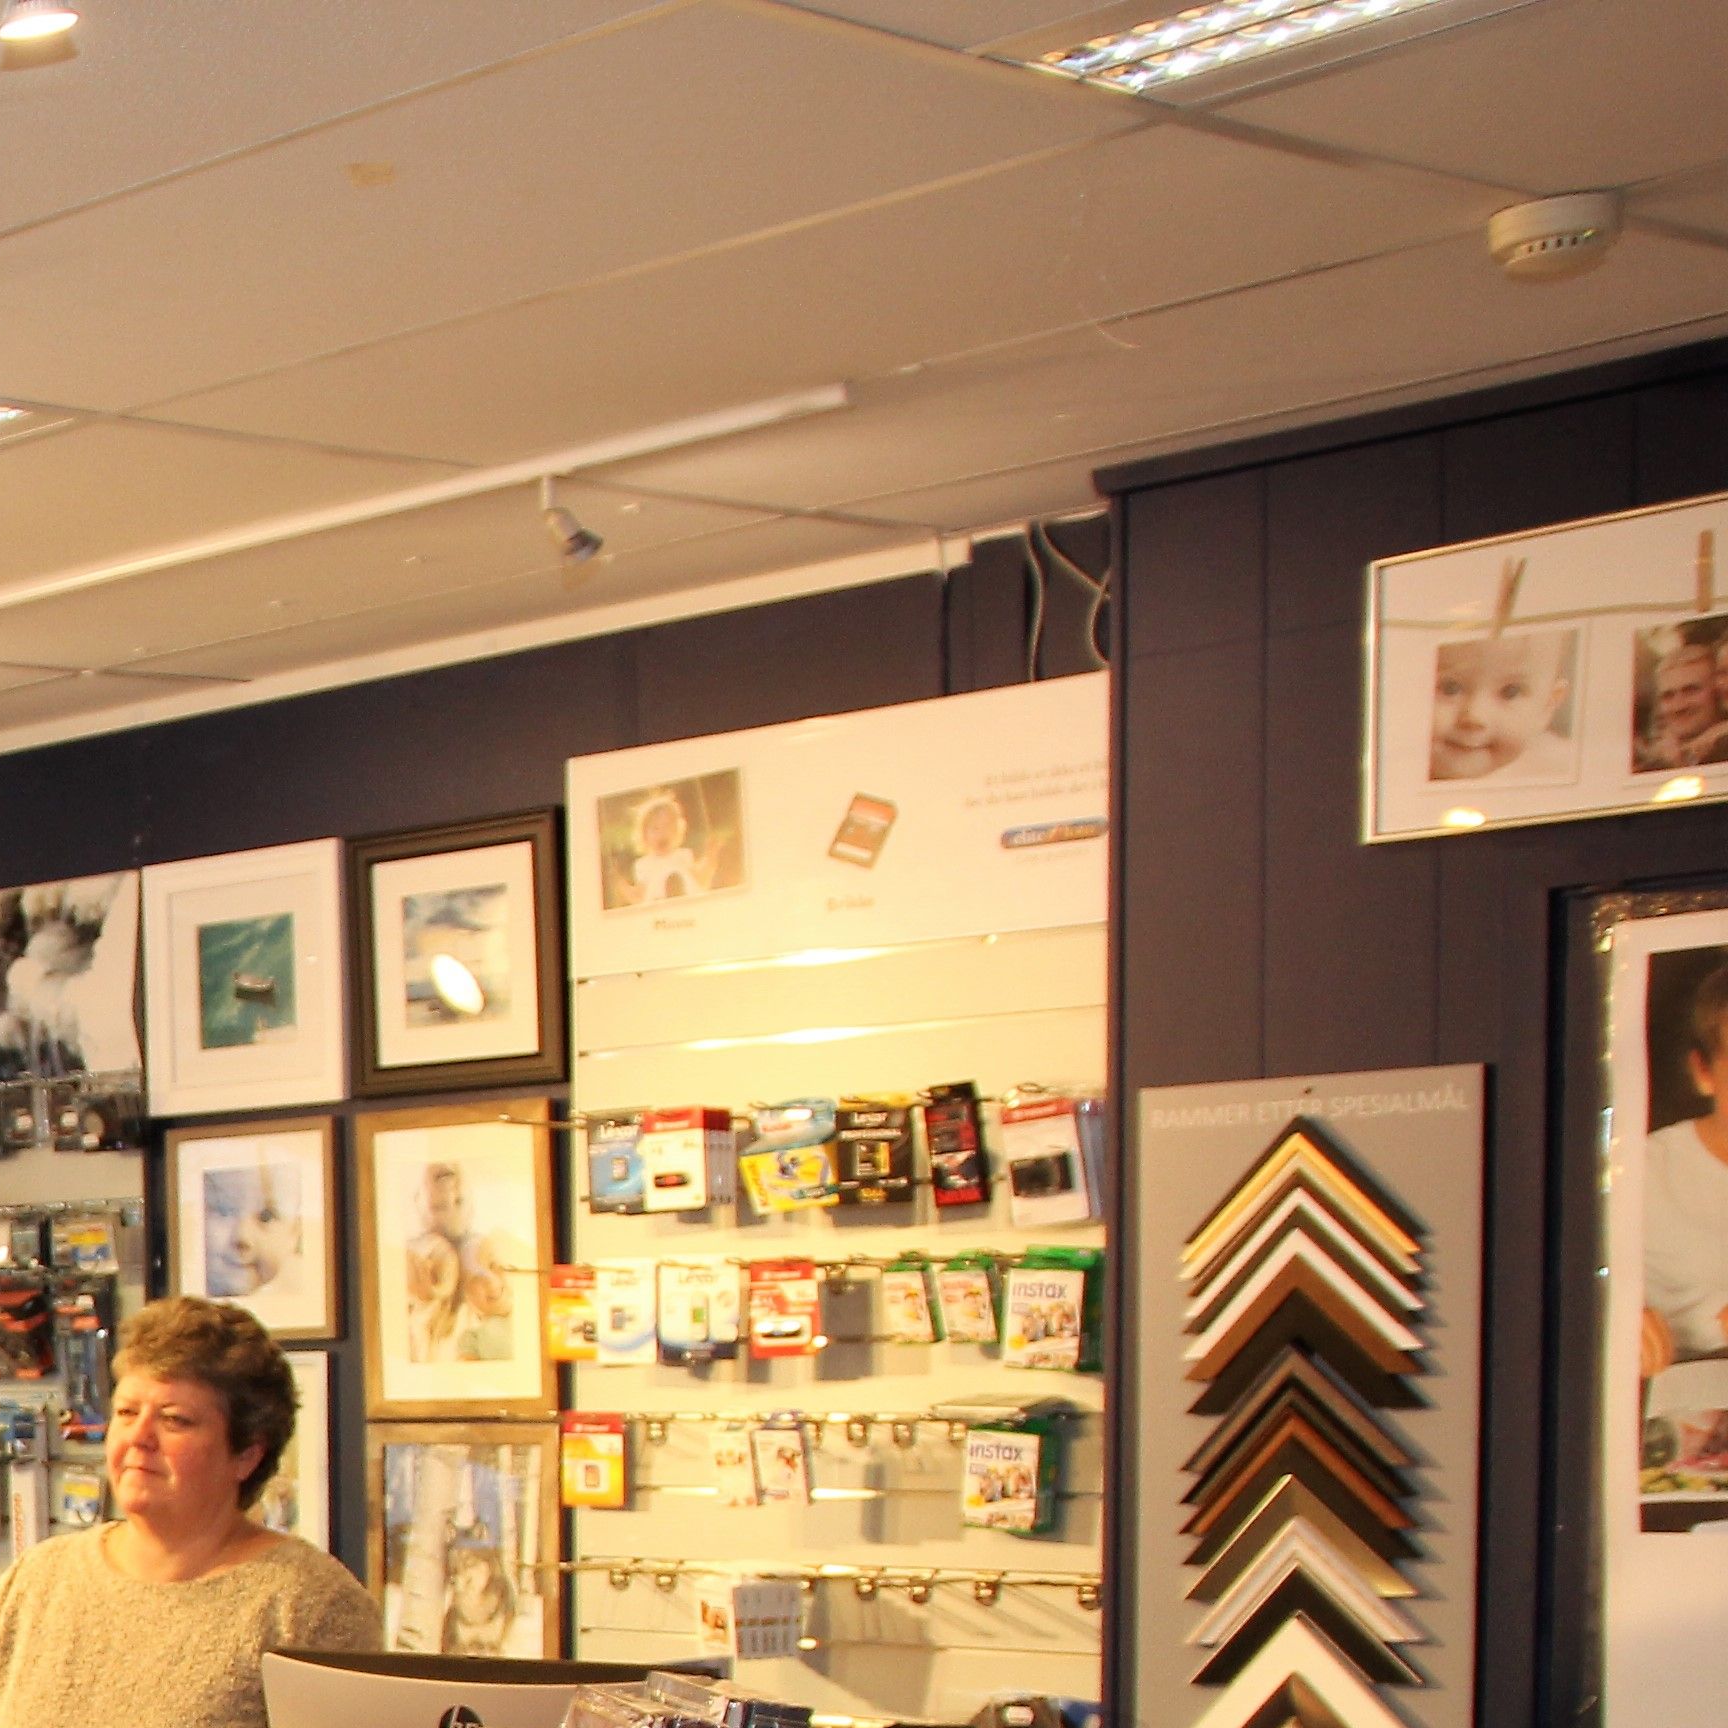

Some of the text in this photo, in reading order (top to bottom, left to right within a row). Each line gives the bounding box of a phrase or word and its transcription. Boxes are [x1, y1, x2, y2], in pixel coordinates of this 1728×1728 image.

[1151, 1102, 1252, 1129] RAMMER
[1011, 1279, 1068, 1300] instax
[969, 1442, 1024, 1462] instax
